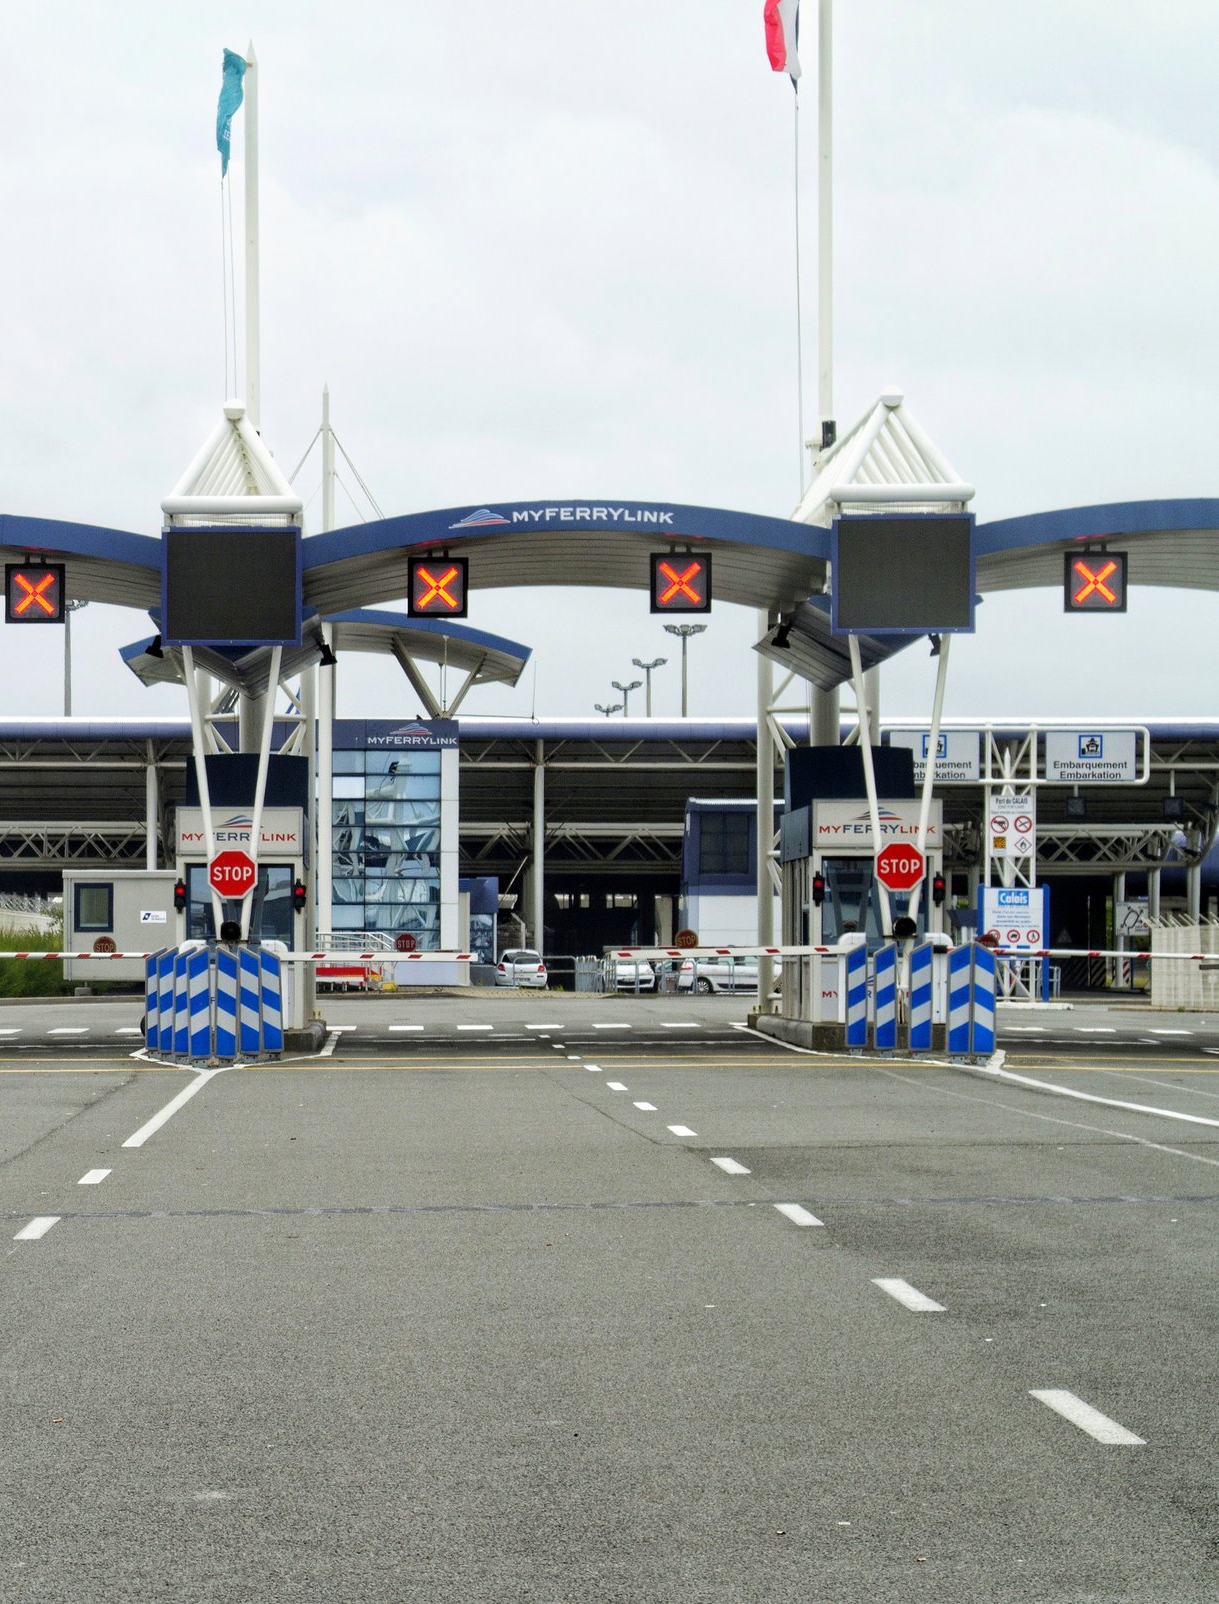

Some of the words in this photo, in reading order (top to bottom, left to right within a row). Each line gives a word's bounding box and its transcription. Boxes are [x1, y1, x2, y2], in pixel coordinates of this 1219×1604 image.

[512, 508, 673, 524] MYFERRYLINK
[367, 736, 458, 745] MYFERRYLINK
[1053, 761, 1128, 771] Embarquement
[1060, 771, 1122, 779] Embarkation
[181, 832, 296, 842] MYERRLINK
[880, 859, 920, 874] STOP
[213, 866, 252, 881] STOP
[999, 892, 1028, 904] Calais
[397, 939, 415, 948] STOP
[676, 935, 696, 946] STOP
[95, 943, 114, 952] STOP
